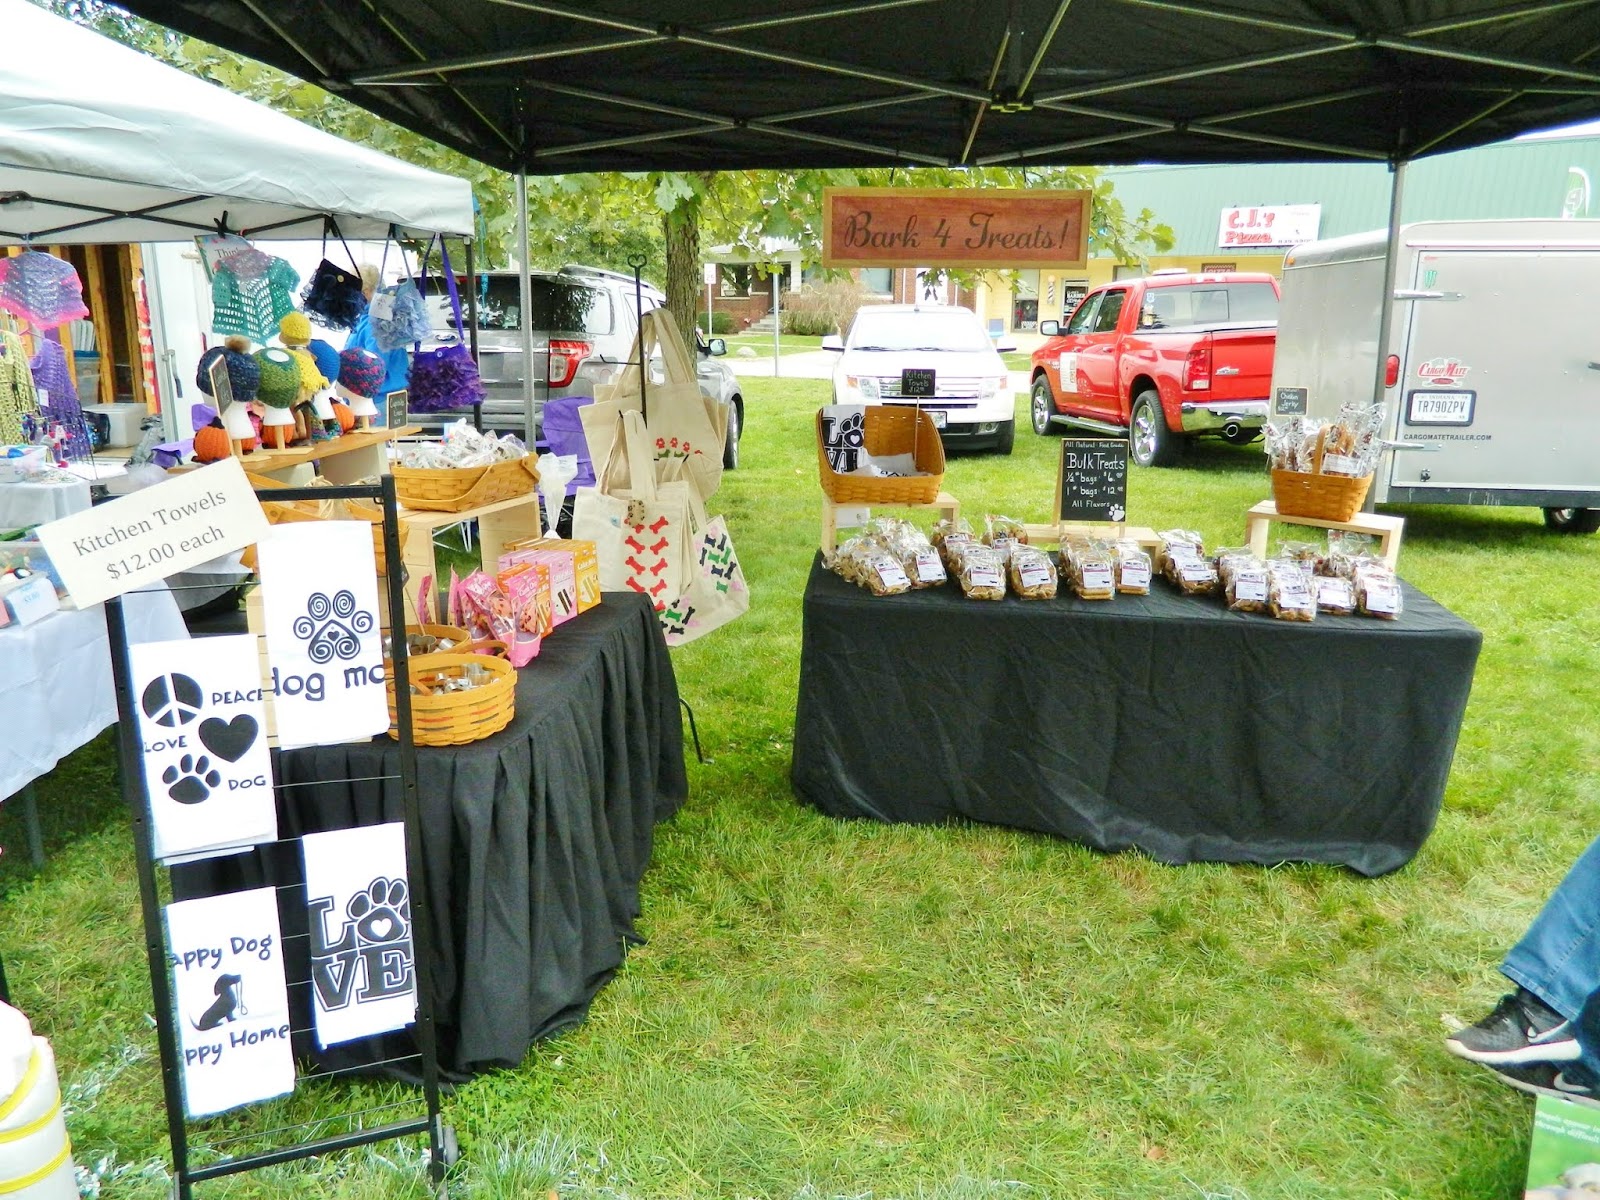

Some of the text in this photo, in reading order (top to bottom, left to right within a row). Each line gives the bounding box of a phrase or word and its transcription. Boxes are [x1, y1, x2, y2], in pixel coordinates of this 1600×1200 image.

[844, 210, 1069, 250] Bark 4 Treats!
[215, 246, 238, 258] Thin
[906, 370, 932, 379] Kitchen
[1418, 400, 1466, 413] TR790ZPV
[1066, 452, 1125, 470] Bulk Treats
[1080, 472, 1097, 485] bags
[1080, 486, 1097, 498] bags
[1071, 500, 1110, 508] All Flavors
[73, 491, 227, 557] Kitchen Towels
[106, 525, 225, 580] $12.00 each
[343, 664, 385, 689] mo
[212, 688, 263, 706] PEACE
[143, 735, 188, 752] LOVE
[228, 775, 266, 791] DOG
[169, 934, 273, 971] appy Dog
[185, 1024, 290, 1066] ppy Home
